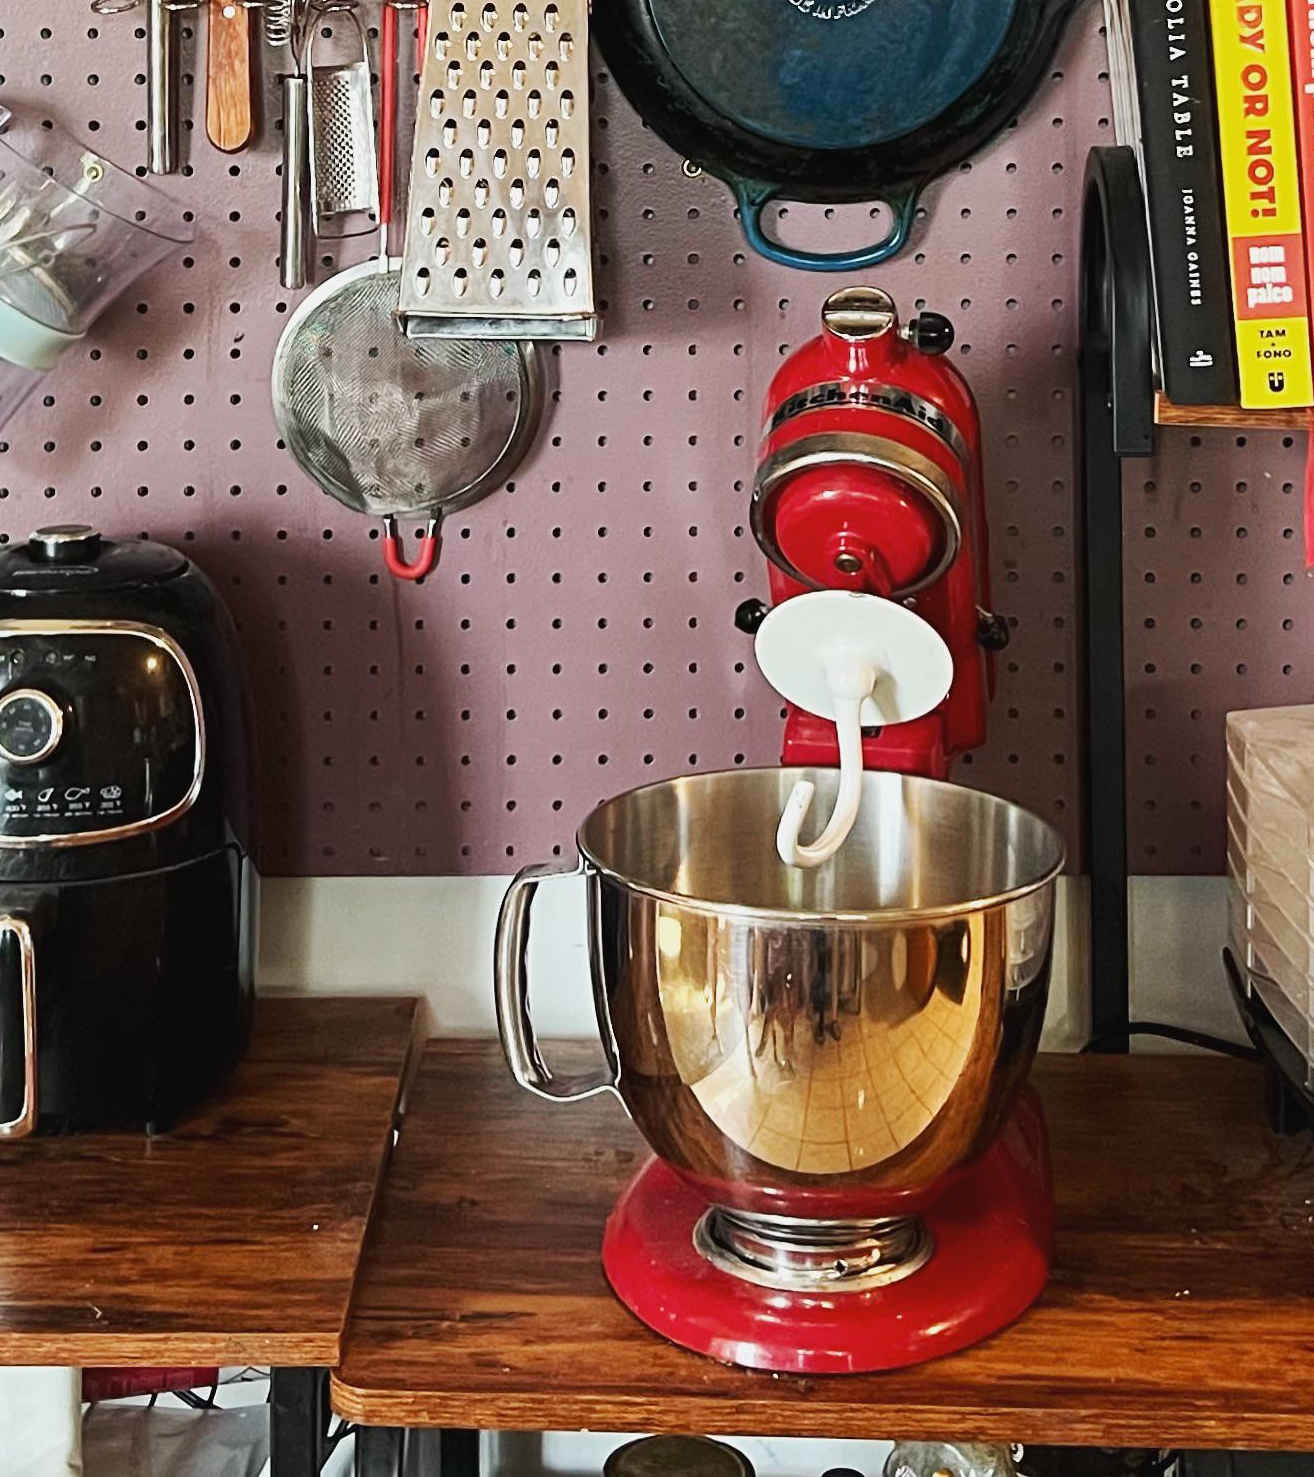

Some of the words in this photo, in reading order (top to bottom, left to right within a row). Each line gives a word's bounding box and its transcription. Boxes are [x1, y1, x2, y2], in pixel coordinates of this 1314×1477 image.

[1171, 75, 1194, 159] TABLE
[1241, 64, 1269, 119] OR
[1246, 129, 1277, 219] NOT!
[1181, 188, 1198, 246] JOANNA
[1187, 252, 1202, 306] GAINES
[1248, 245, 1285, 264] nom
[1250, 266, 1287, 284] nom
[1259, 329, 1286, 338] TAM
